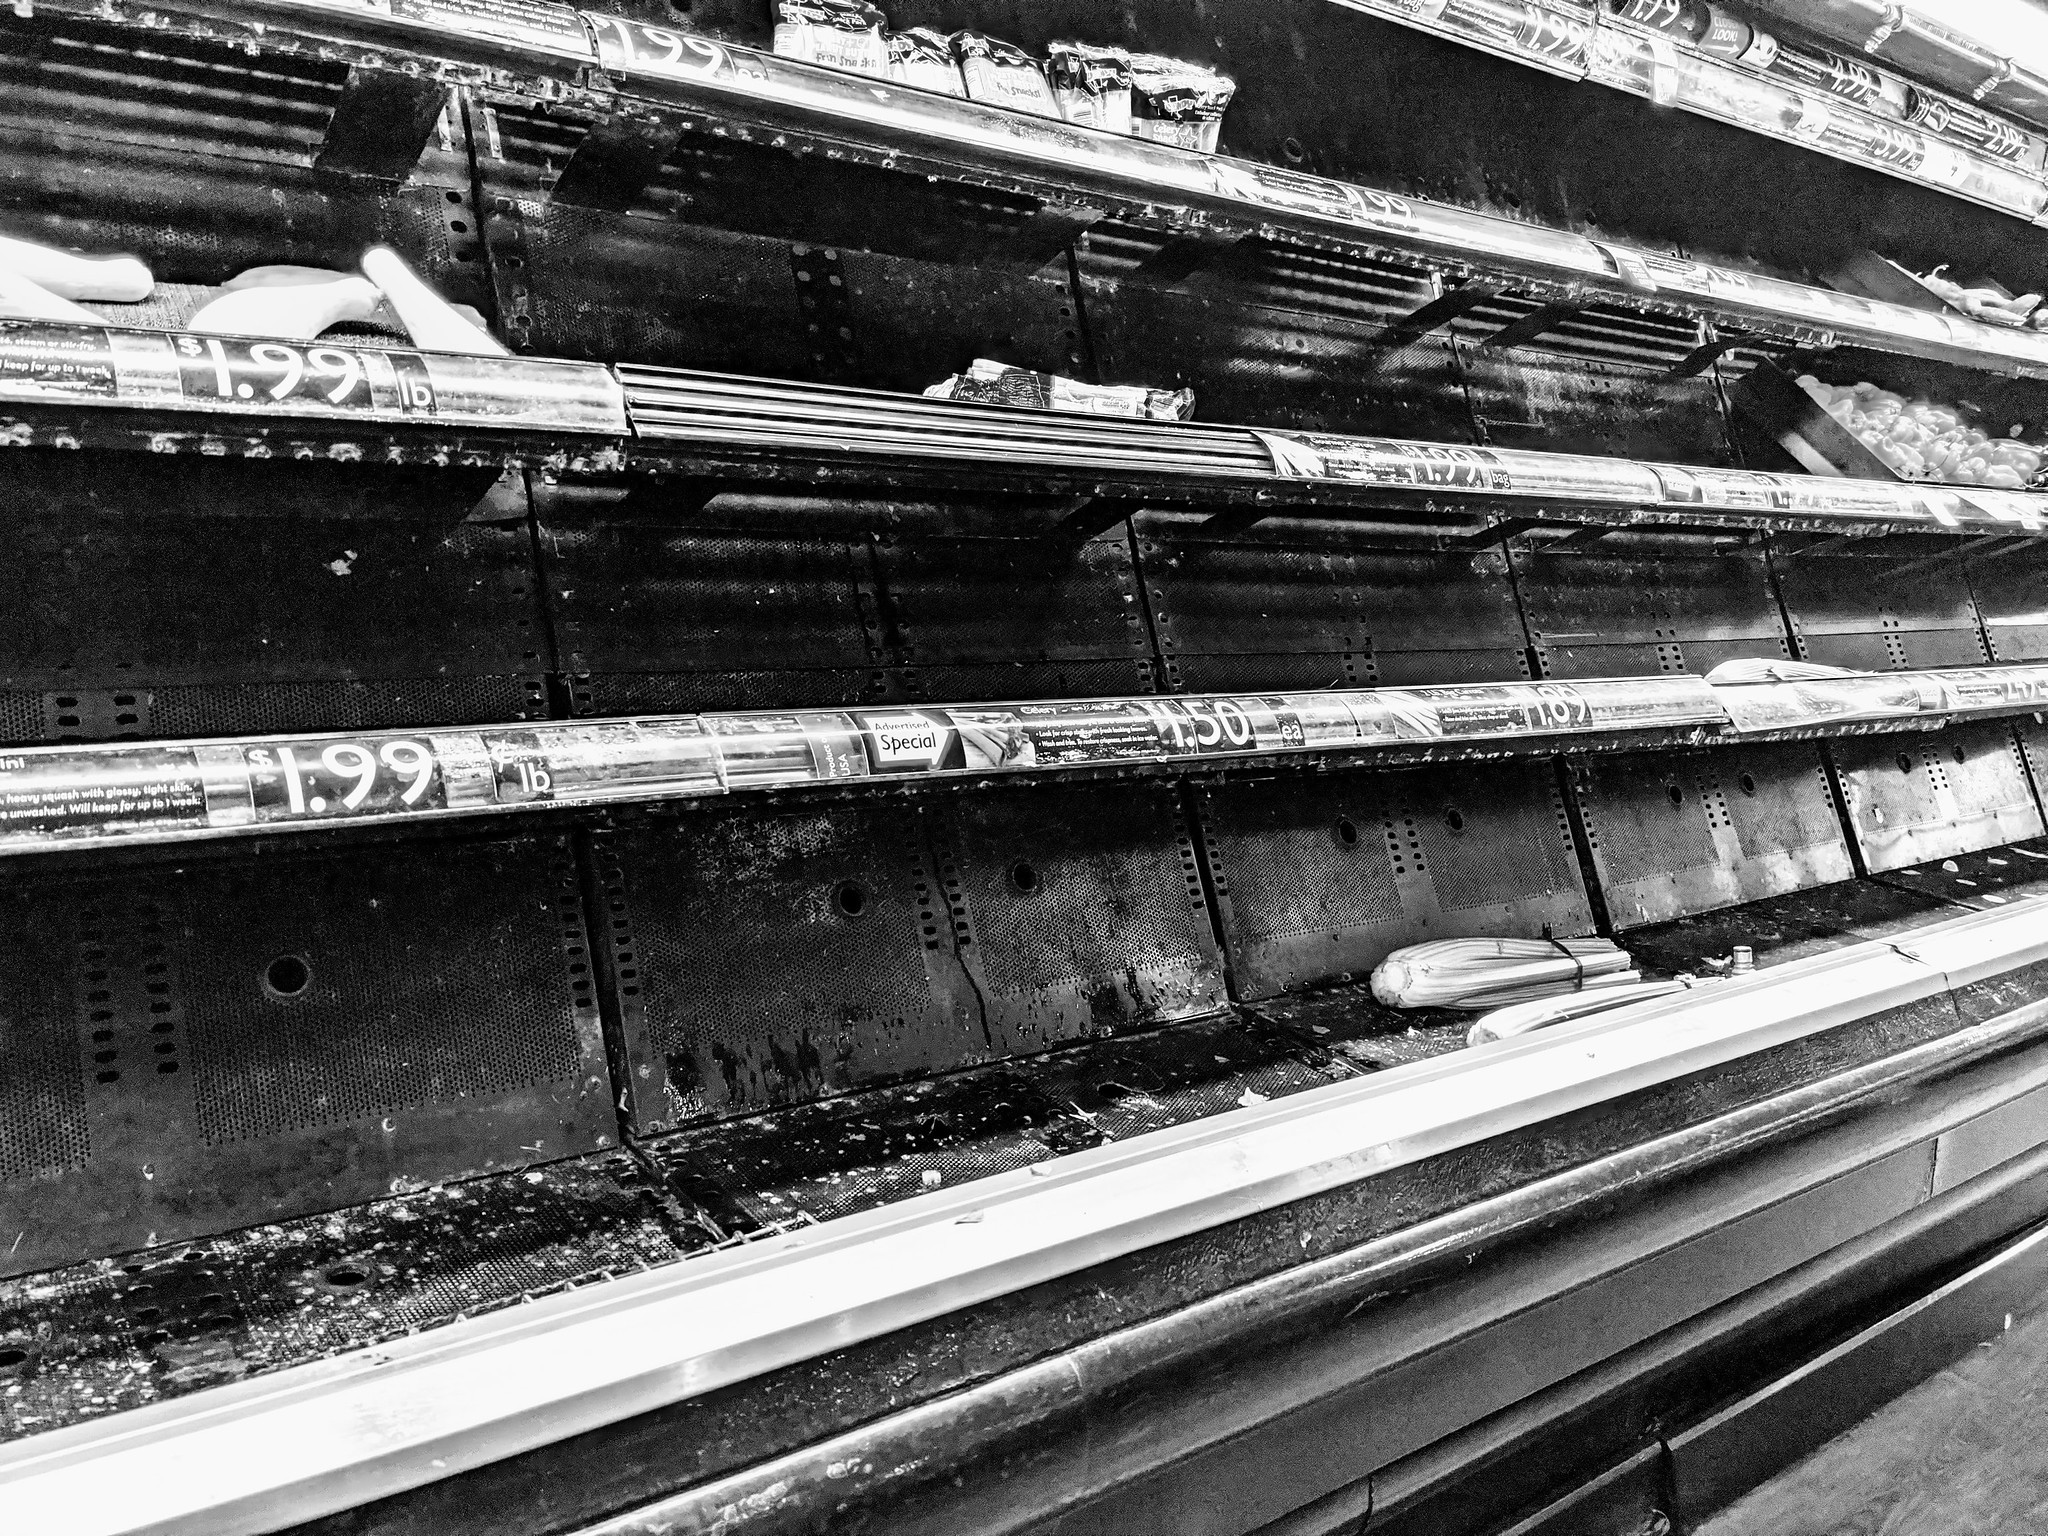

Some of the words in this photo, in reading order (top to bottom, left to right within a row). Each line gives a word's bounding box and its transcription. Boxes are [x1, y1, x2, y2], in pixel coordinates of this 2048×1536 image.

[1711, 28, 1738, 42] LOOK!
[4, 359, 29, 372] keep
[30, 361, 47, 373] for
[47, 362, 61, 374] up
[62, 363, 74, 372] to
[178, 338, 361, 404] $1.99
[397, 369, 432, 406] lb
[1491, 468, 1511, 488] bag
[1282, 718, 1303, 741] ea
[880, 732, 937, 755] Special
[838, 753, 851, 777] USA
[248, 740, 434, 814] $1.99
[518, 762, 551, 793] lb
[7, 793, 40, 804] heavy
[42, 790, 80, 803] squash
[82, 788, 104, 800] with
[170, 780, 193, 793] skin.
[10, 804, 67, 819] unwashed.
[70, 802, 91, 814] Will
[92, 801, 118, 814] keep
[120, 800, 136, 813] for
[137, 801, 151, 812] up
[153, 799, 164, 808] to
